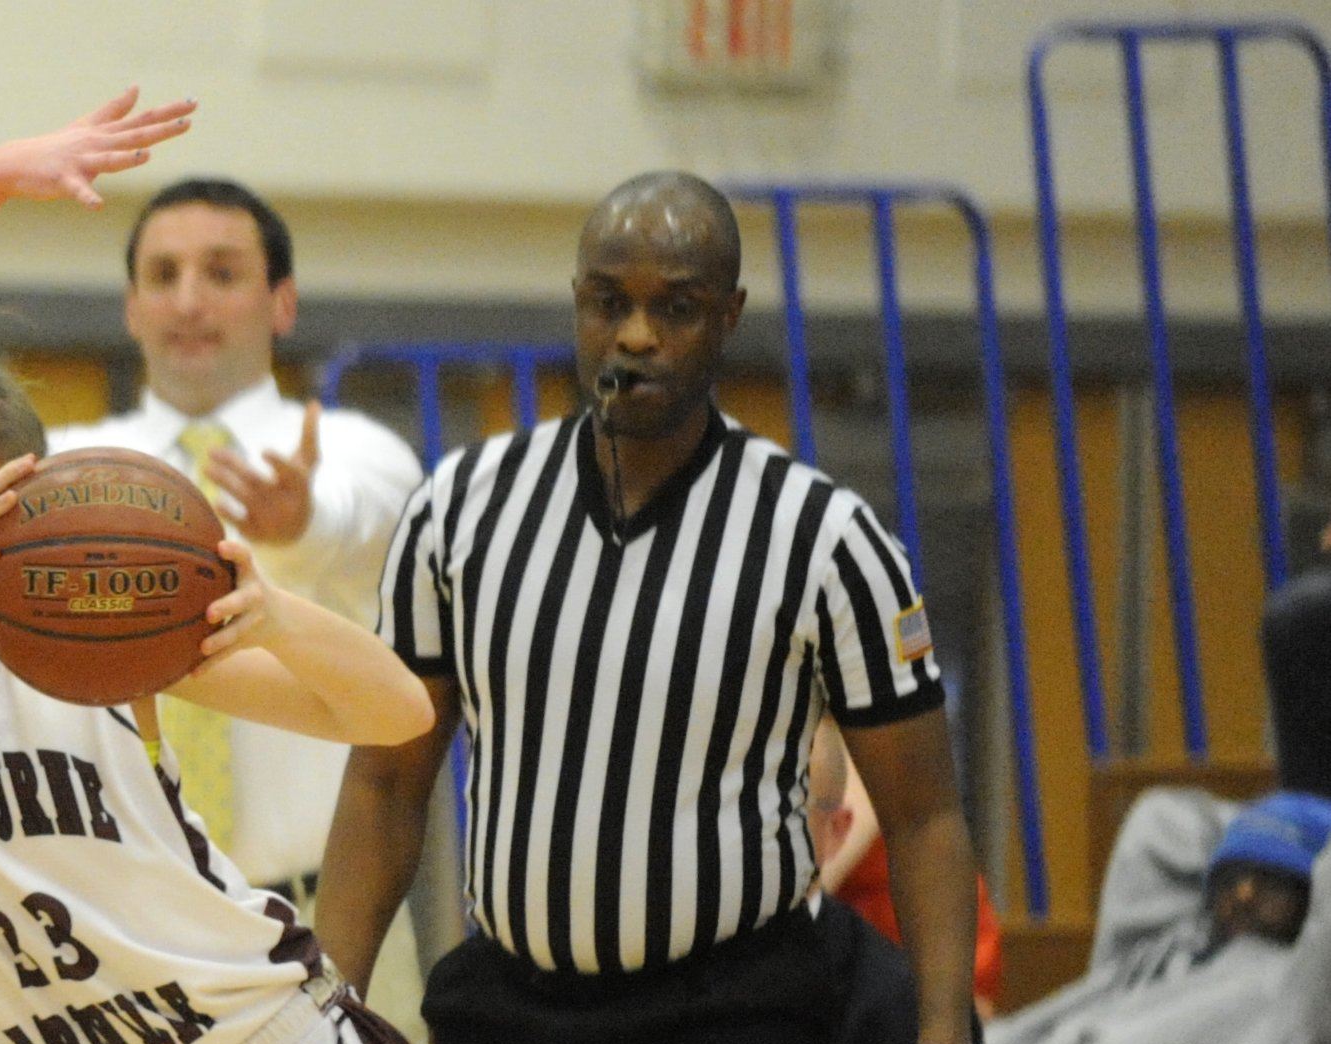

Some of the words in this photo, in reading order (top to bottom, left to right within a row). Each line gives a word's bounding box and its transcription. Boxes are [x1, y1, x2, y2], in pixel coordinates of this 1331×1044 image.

[20, 482, 185, 527] SPALDING
[23, 568, 181, 596] TF-1000
[69, 599, 133, 612] CLASSIC
